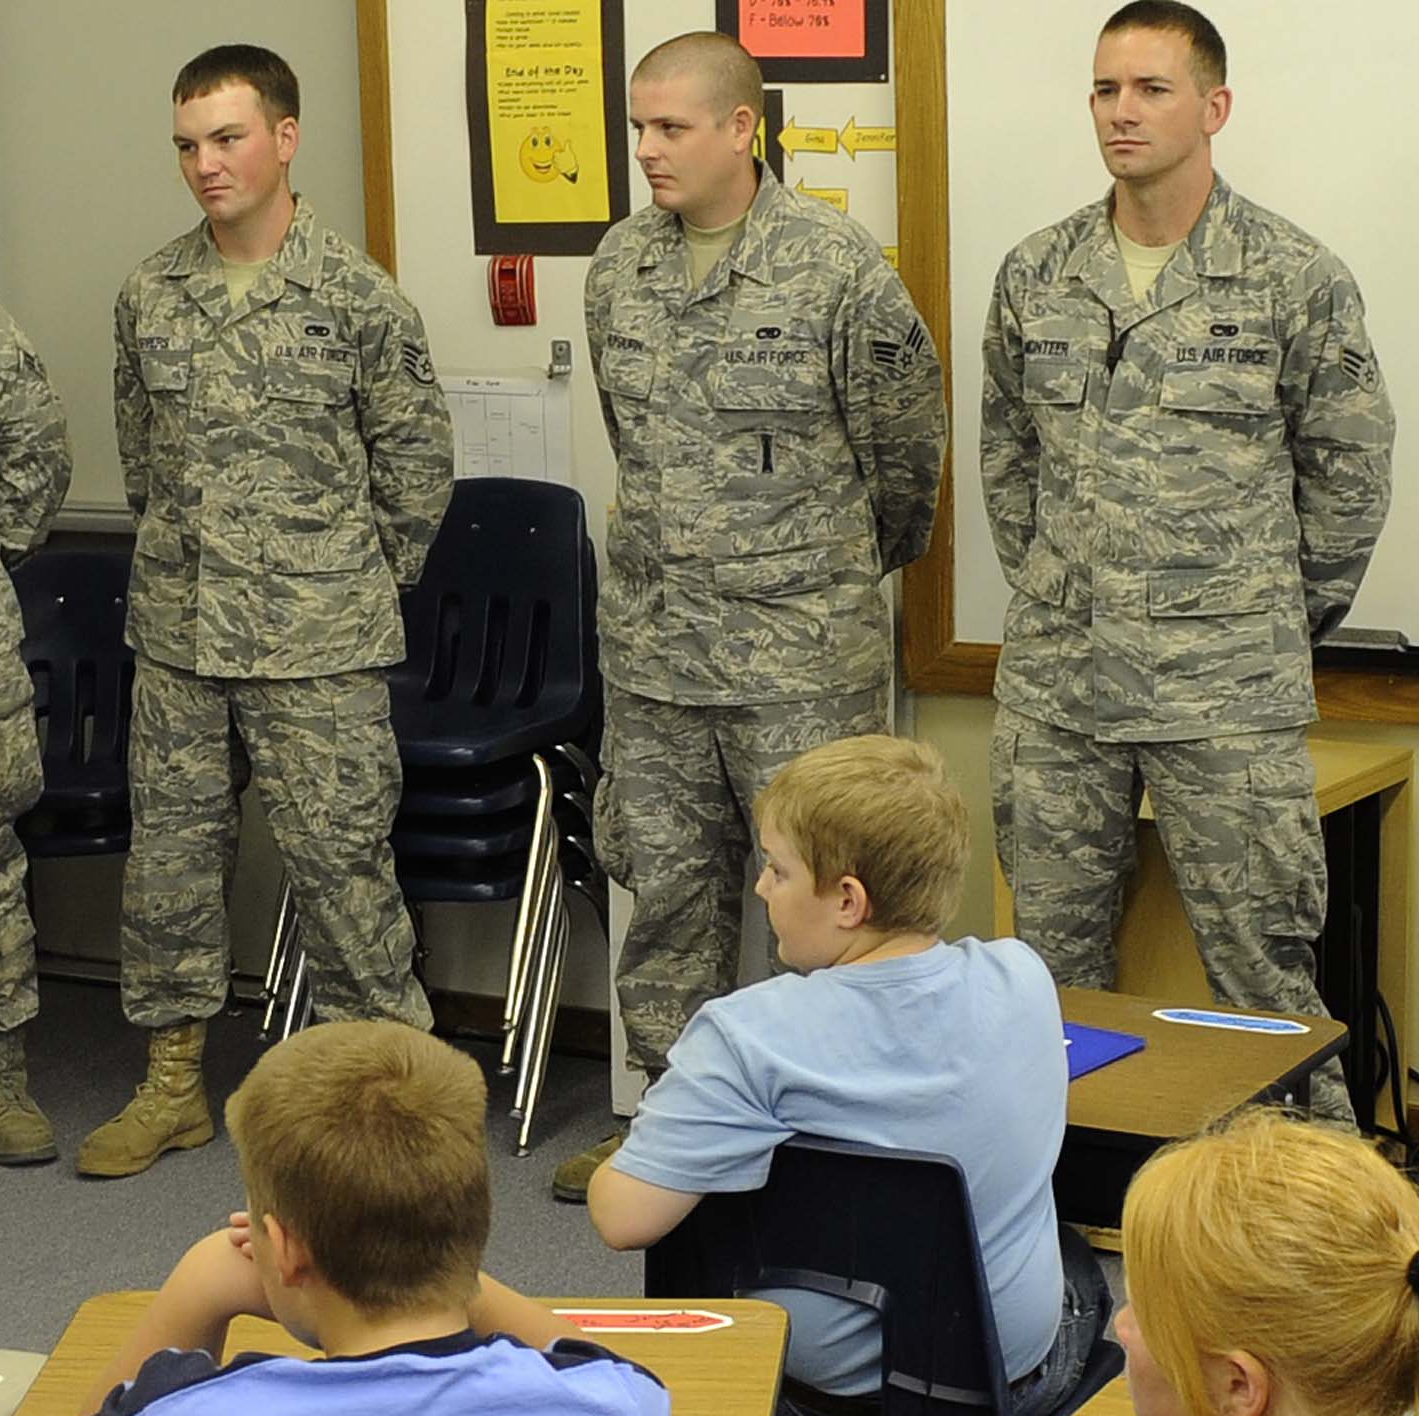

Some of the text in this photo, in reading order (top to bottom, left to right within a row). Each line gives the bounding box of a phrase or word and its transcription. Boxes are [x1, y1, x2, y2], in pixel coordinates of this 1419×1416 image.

[749, 12, 756, 26] F
[769, 13, 804, 27] Below
[505, 67, 524, 77] End
[527, 65, 539, 79] of
[564, 65, 584, 77] Day
[724, 350, 808, 365] U.S. AIR FORCE
[1175, 347, 1268, 366] U.S. AIR FORCE
